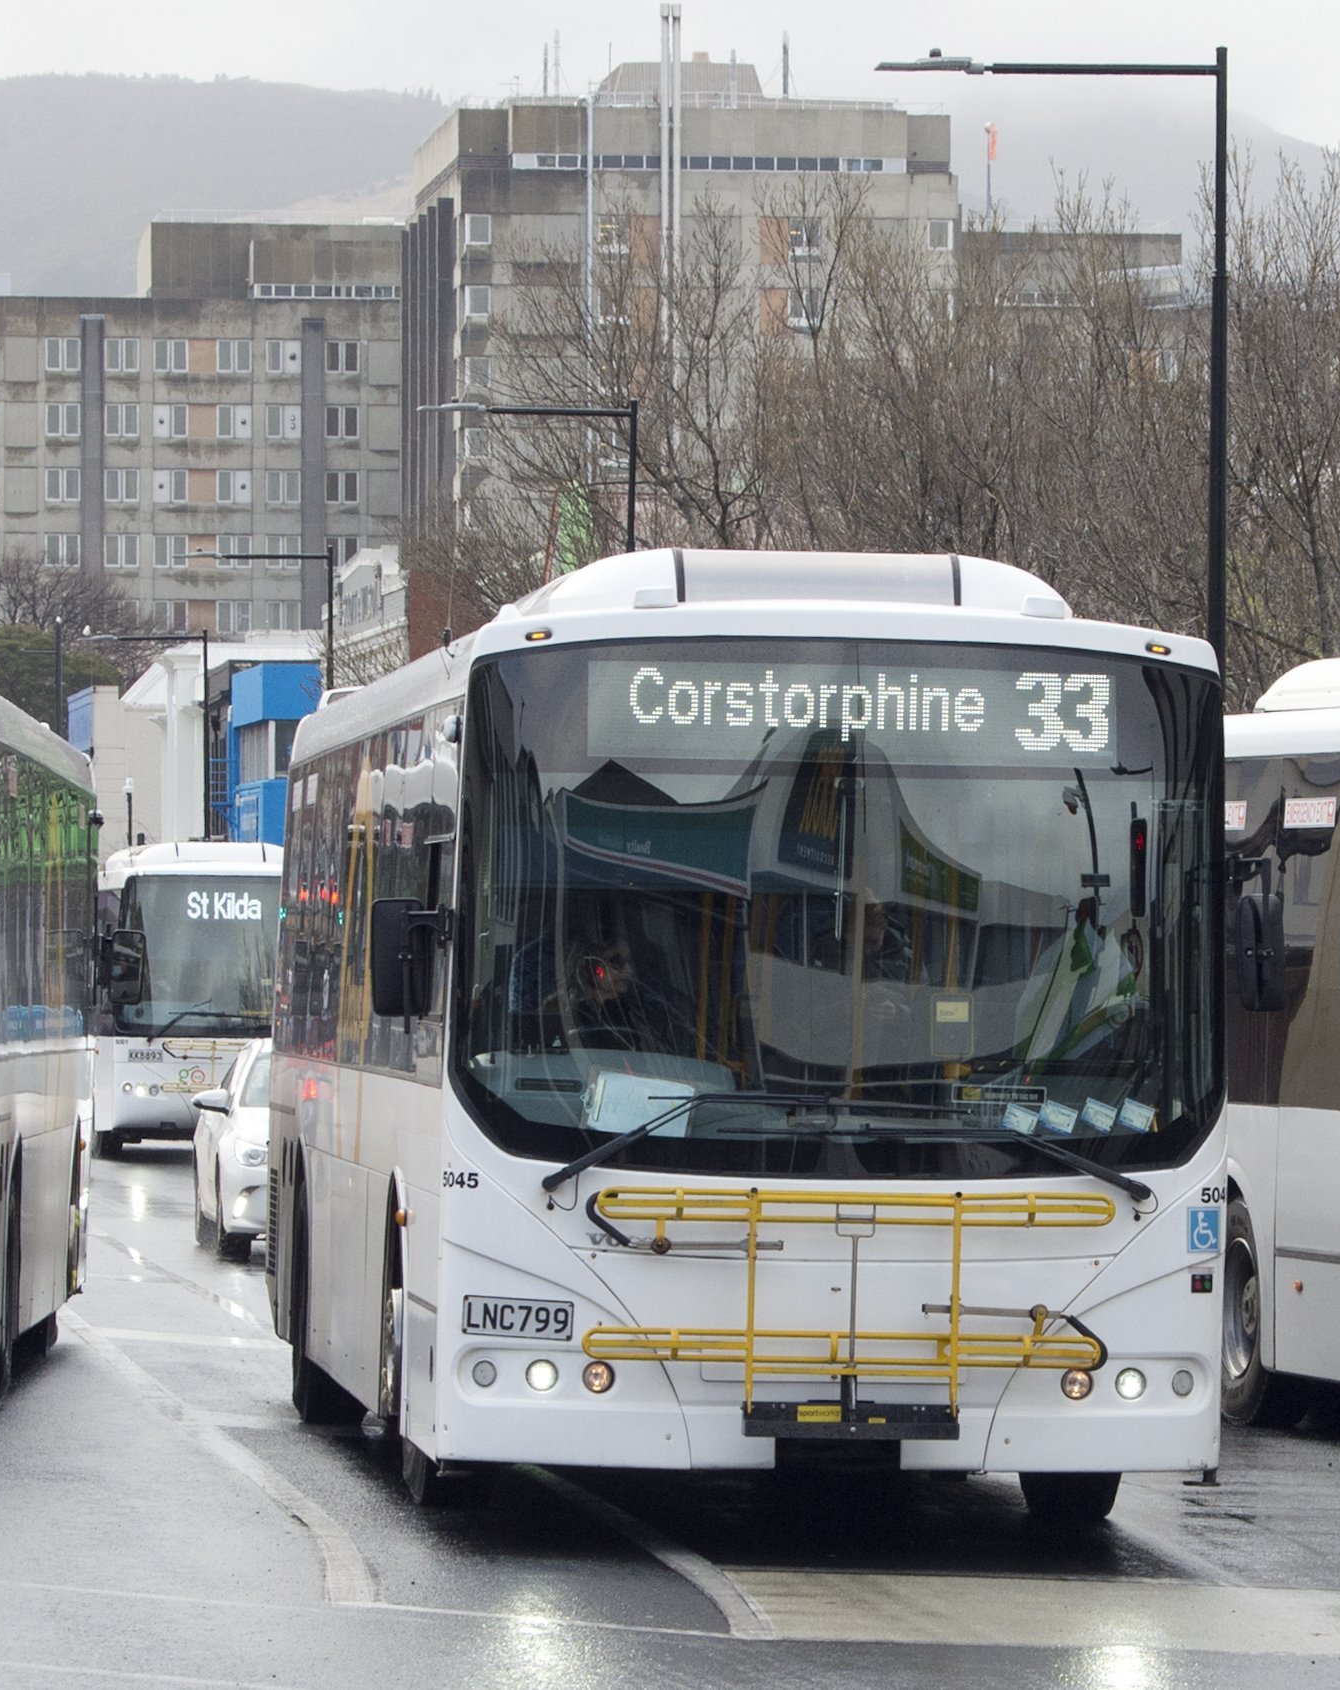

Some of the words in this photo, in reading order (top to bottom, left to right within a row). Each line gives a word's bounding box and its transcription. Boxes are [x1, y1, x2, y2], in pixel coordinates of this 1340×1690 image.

[629, 666, 985, 743] Corstorphine
[1015, 672, 1110, 752] 33
[186, 891, 209, 919] St
[213, 891, 262, 920] Kilda
[443, 1171, 479, 1189] 5045
[466, 1301, 569, 1334] LNC799
